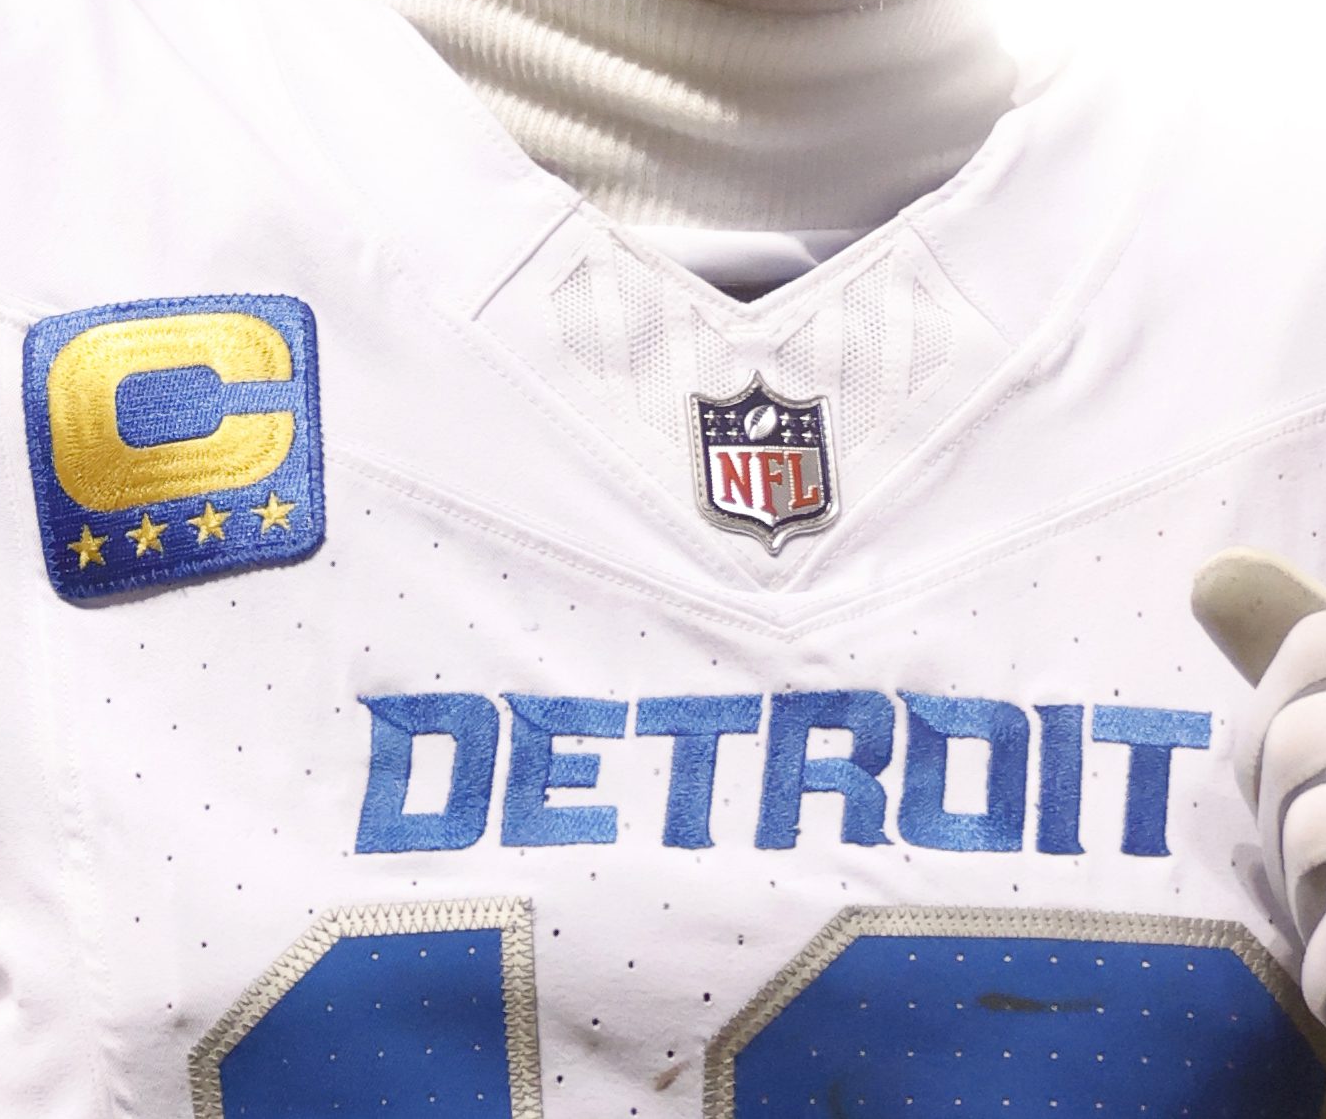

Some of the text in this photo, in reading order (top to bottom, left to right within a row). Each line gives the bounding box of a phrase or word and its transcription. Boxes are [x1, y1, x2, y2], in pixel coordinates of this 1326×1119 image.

[47, 312, 295, 513] C
[716, 450, 820, 516] NFL
[354, 690, 1213, 857] DETROIT
